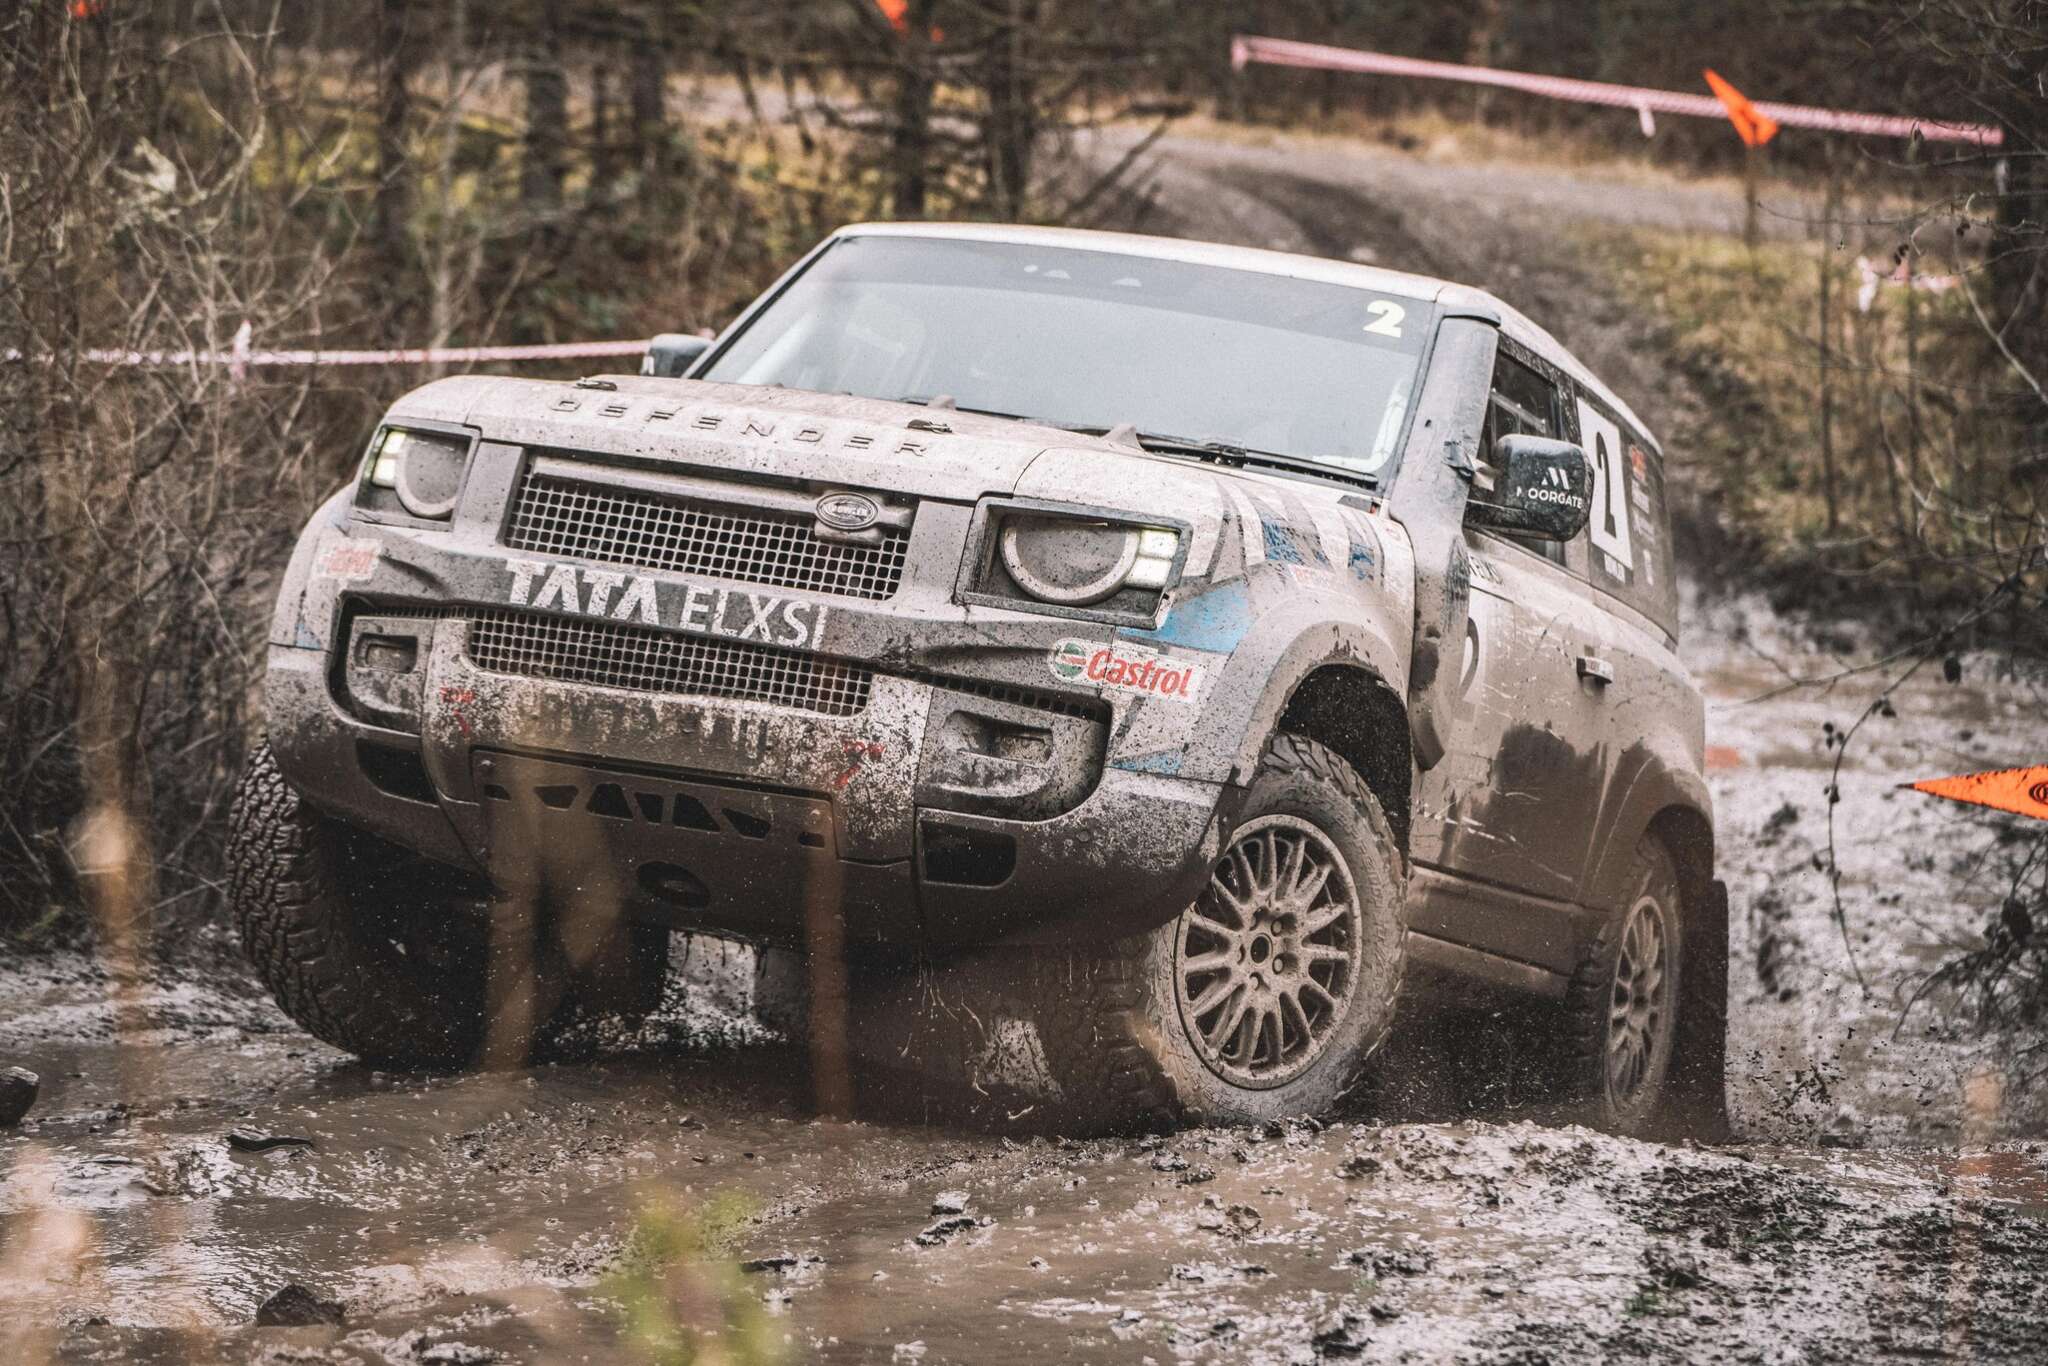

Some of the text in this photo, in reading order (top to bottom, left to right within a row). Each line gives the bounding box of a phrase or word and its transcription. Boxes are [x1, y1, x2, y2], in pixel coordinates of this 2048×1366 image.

[1363, 300, 1405, 338] 2
[550, 398, 927, 457] DEFENDER
[1595, 431, 1617, 539] 2
[505, 558, 829, 651] TATA ELXSI
[1087, 649, 1194, 697] Castrol
